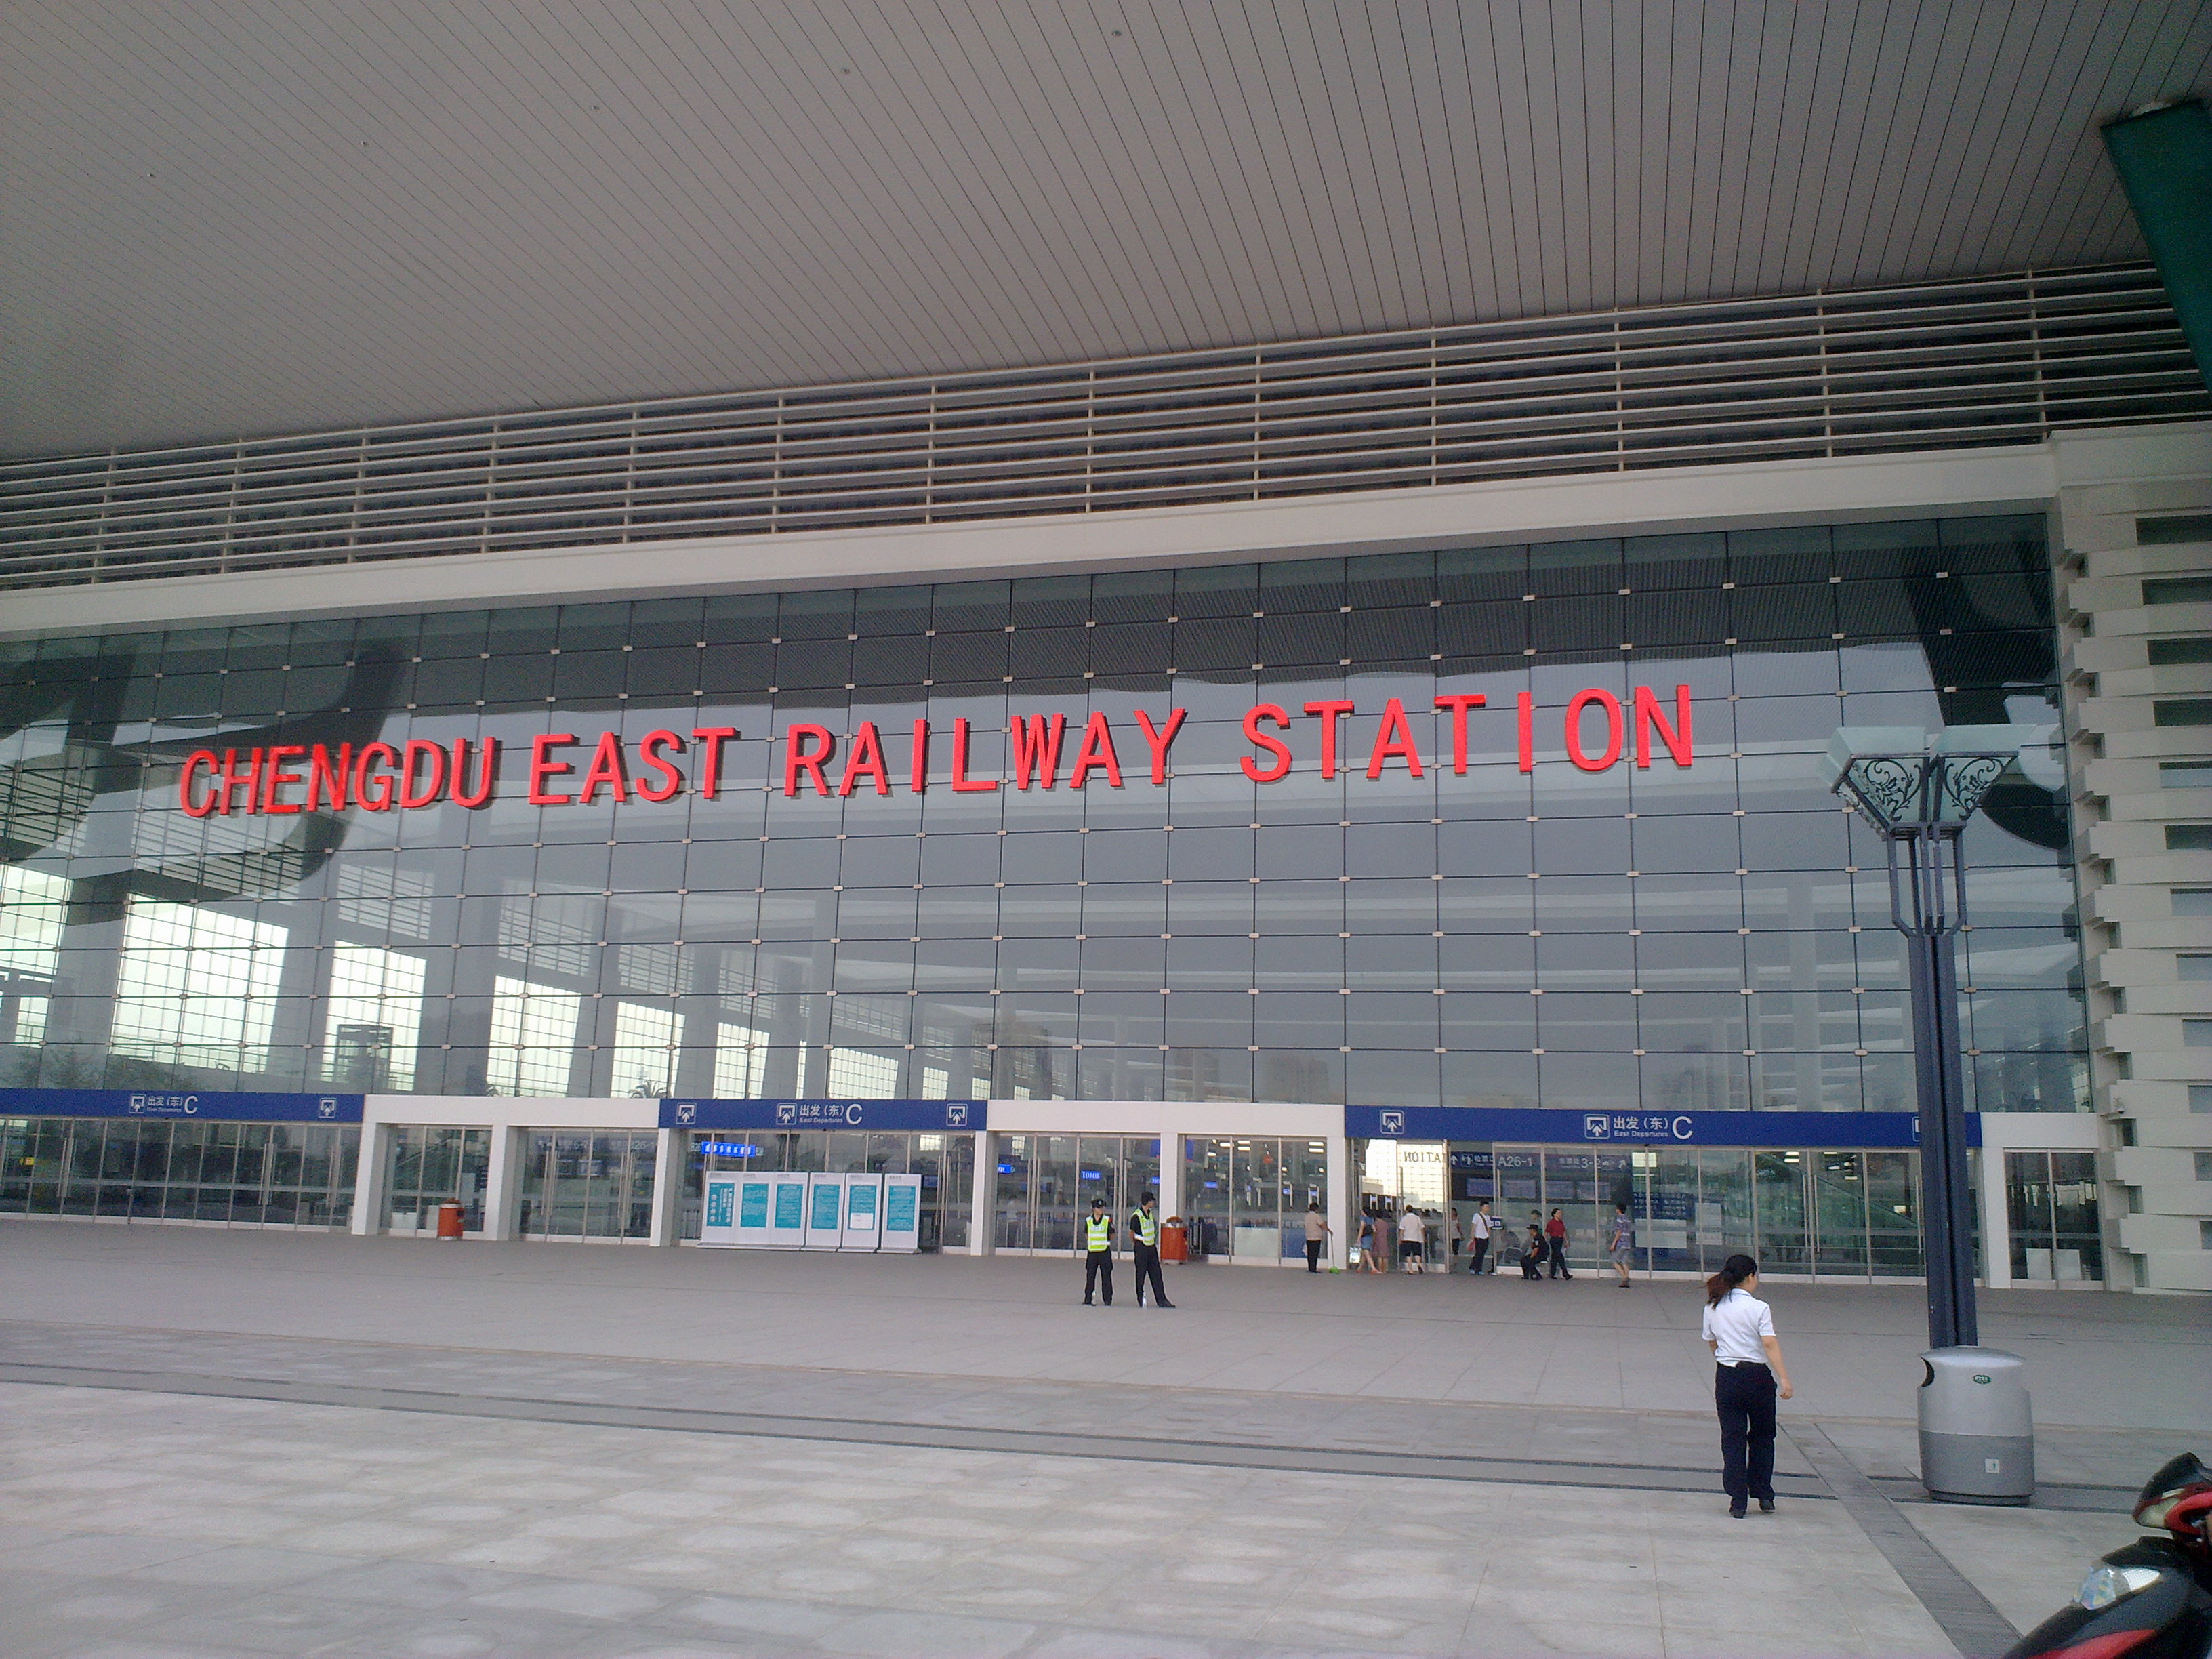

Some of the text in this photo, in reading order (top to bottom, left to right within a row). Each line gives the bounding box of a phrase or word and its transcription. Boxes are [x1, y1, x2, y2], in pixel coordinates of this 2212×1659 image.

[180, 684, 1694, 818] CHENGDU EAST RAILWAY STATION
[184, 1095, 198, 1114] C
[846, 1103, 863, 1125] C
[1672, 1115, 1694, 1139] C
[1498, 1155, 1532, 1167] A26-1
